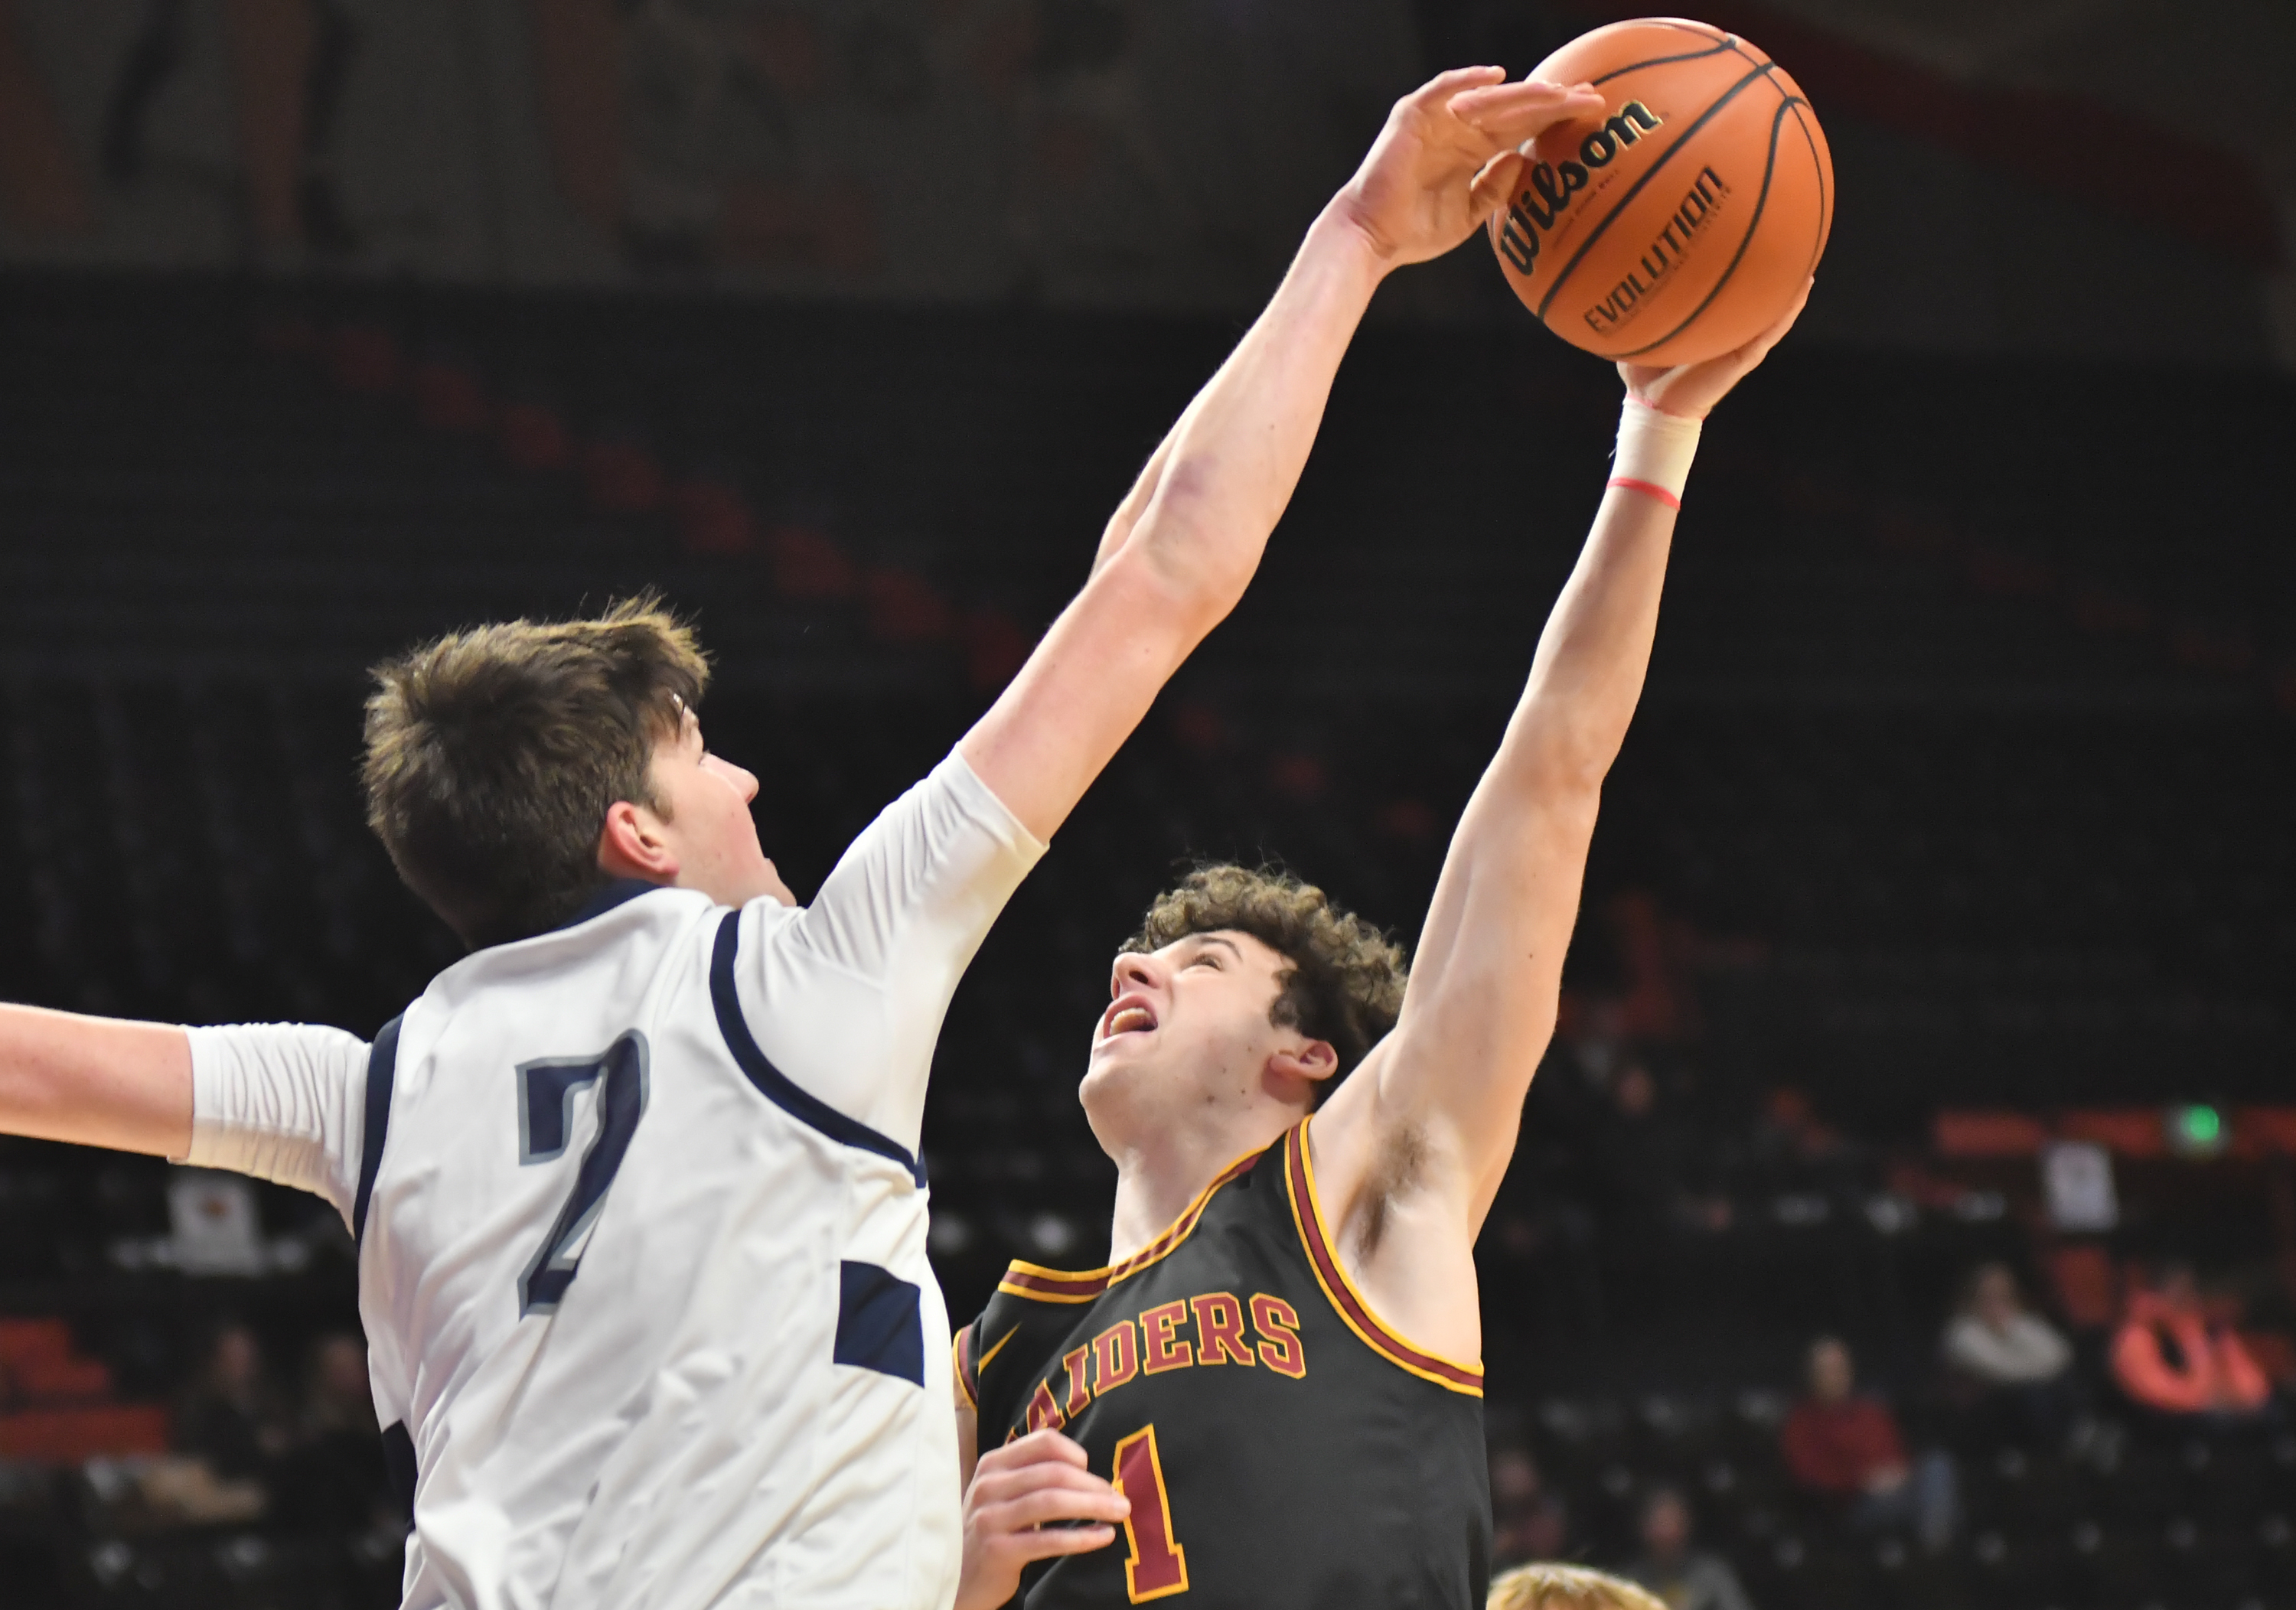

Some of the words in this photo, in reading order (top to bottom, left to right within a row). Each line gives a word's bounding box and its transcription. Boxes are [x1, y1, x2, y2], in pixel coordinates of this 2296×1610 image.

[1500, 99, 1664, 276] Wilson
[1583, 165, 1724, 334] EVOLUTION
[514, 1028, 650, 1322] 2
[1004, 1291, 1306, 1446] AIDERS
